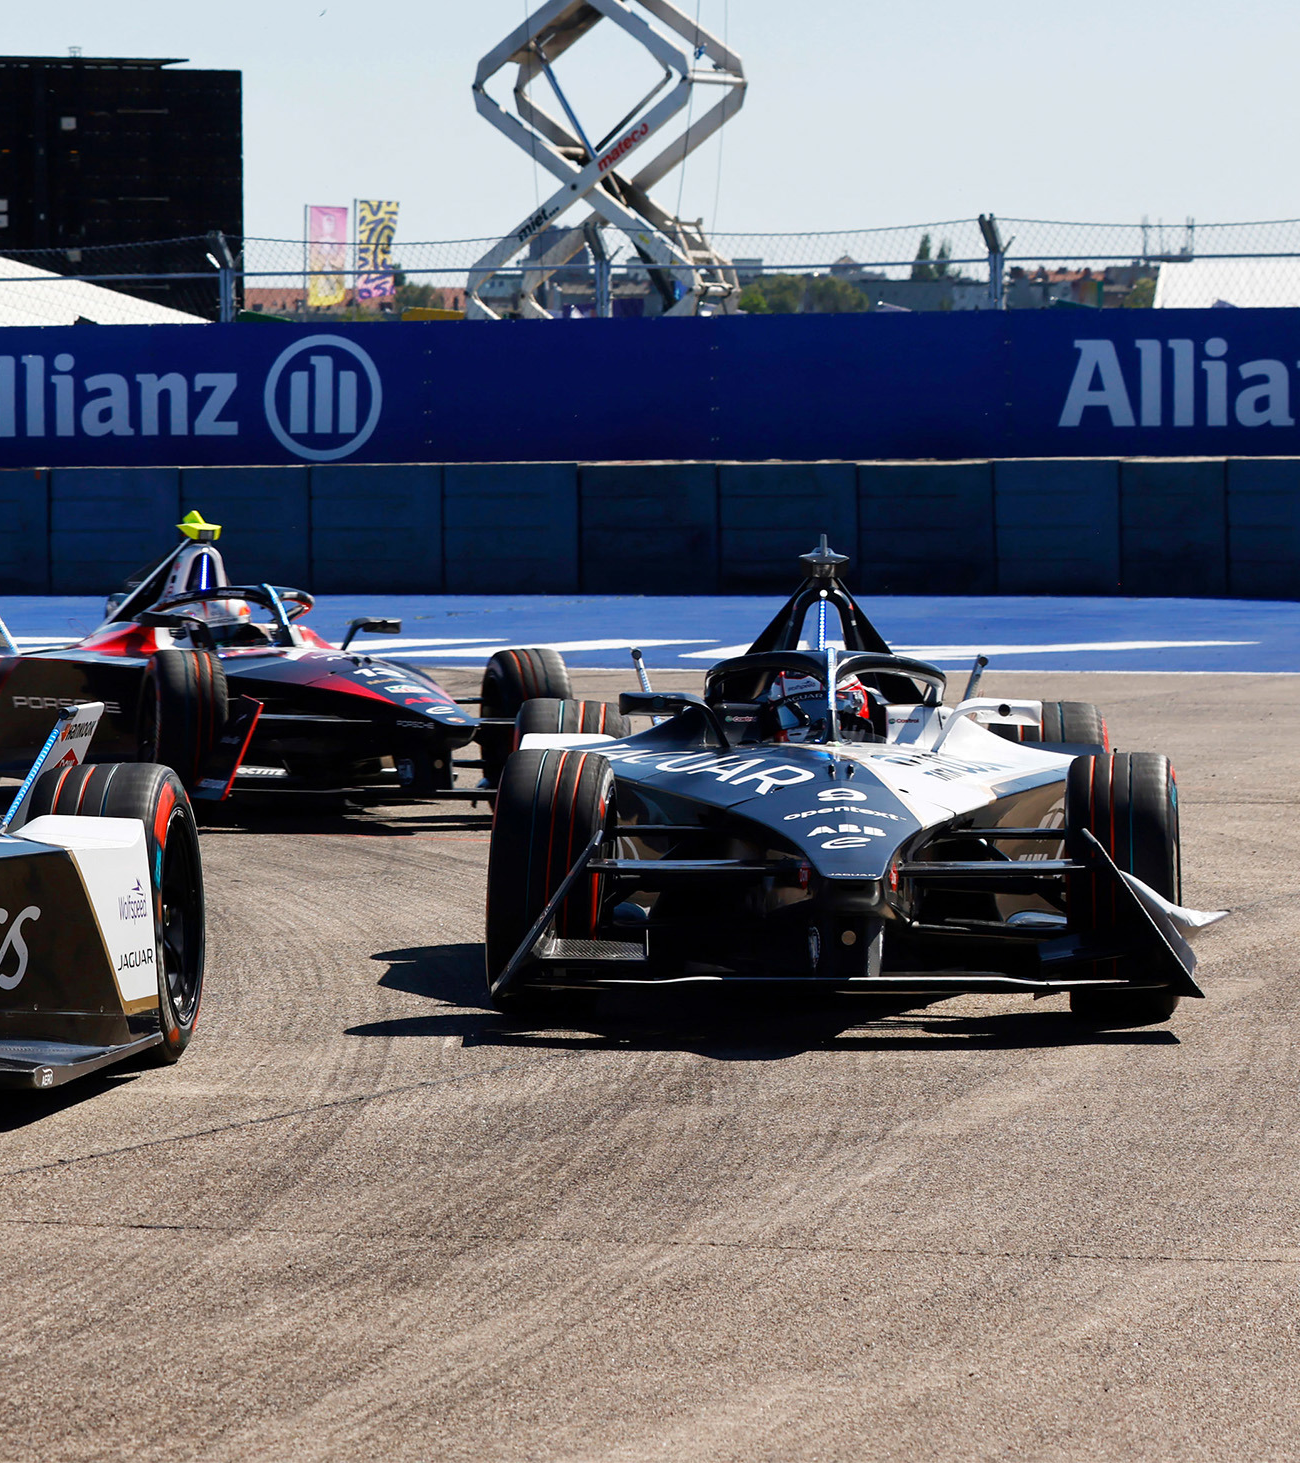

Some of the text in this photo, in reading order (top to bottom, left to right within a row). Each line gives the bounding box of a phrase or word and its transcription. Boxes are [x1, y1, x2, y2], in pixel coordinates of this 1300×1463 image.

[597, 123, 649, 172] mateco
[1058, 337, 1300, 427] Allia
[12, 696, 122, 714] PORSE
[235, 767, 287, 776] OCTITE
[816, 787, 868, 802] 9
[806, 823, 887, 837] ABB
[117, 948, 154, 972] JAGUAR
